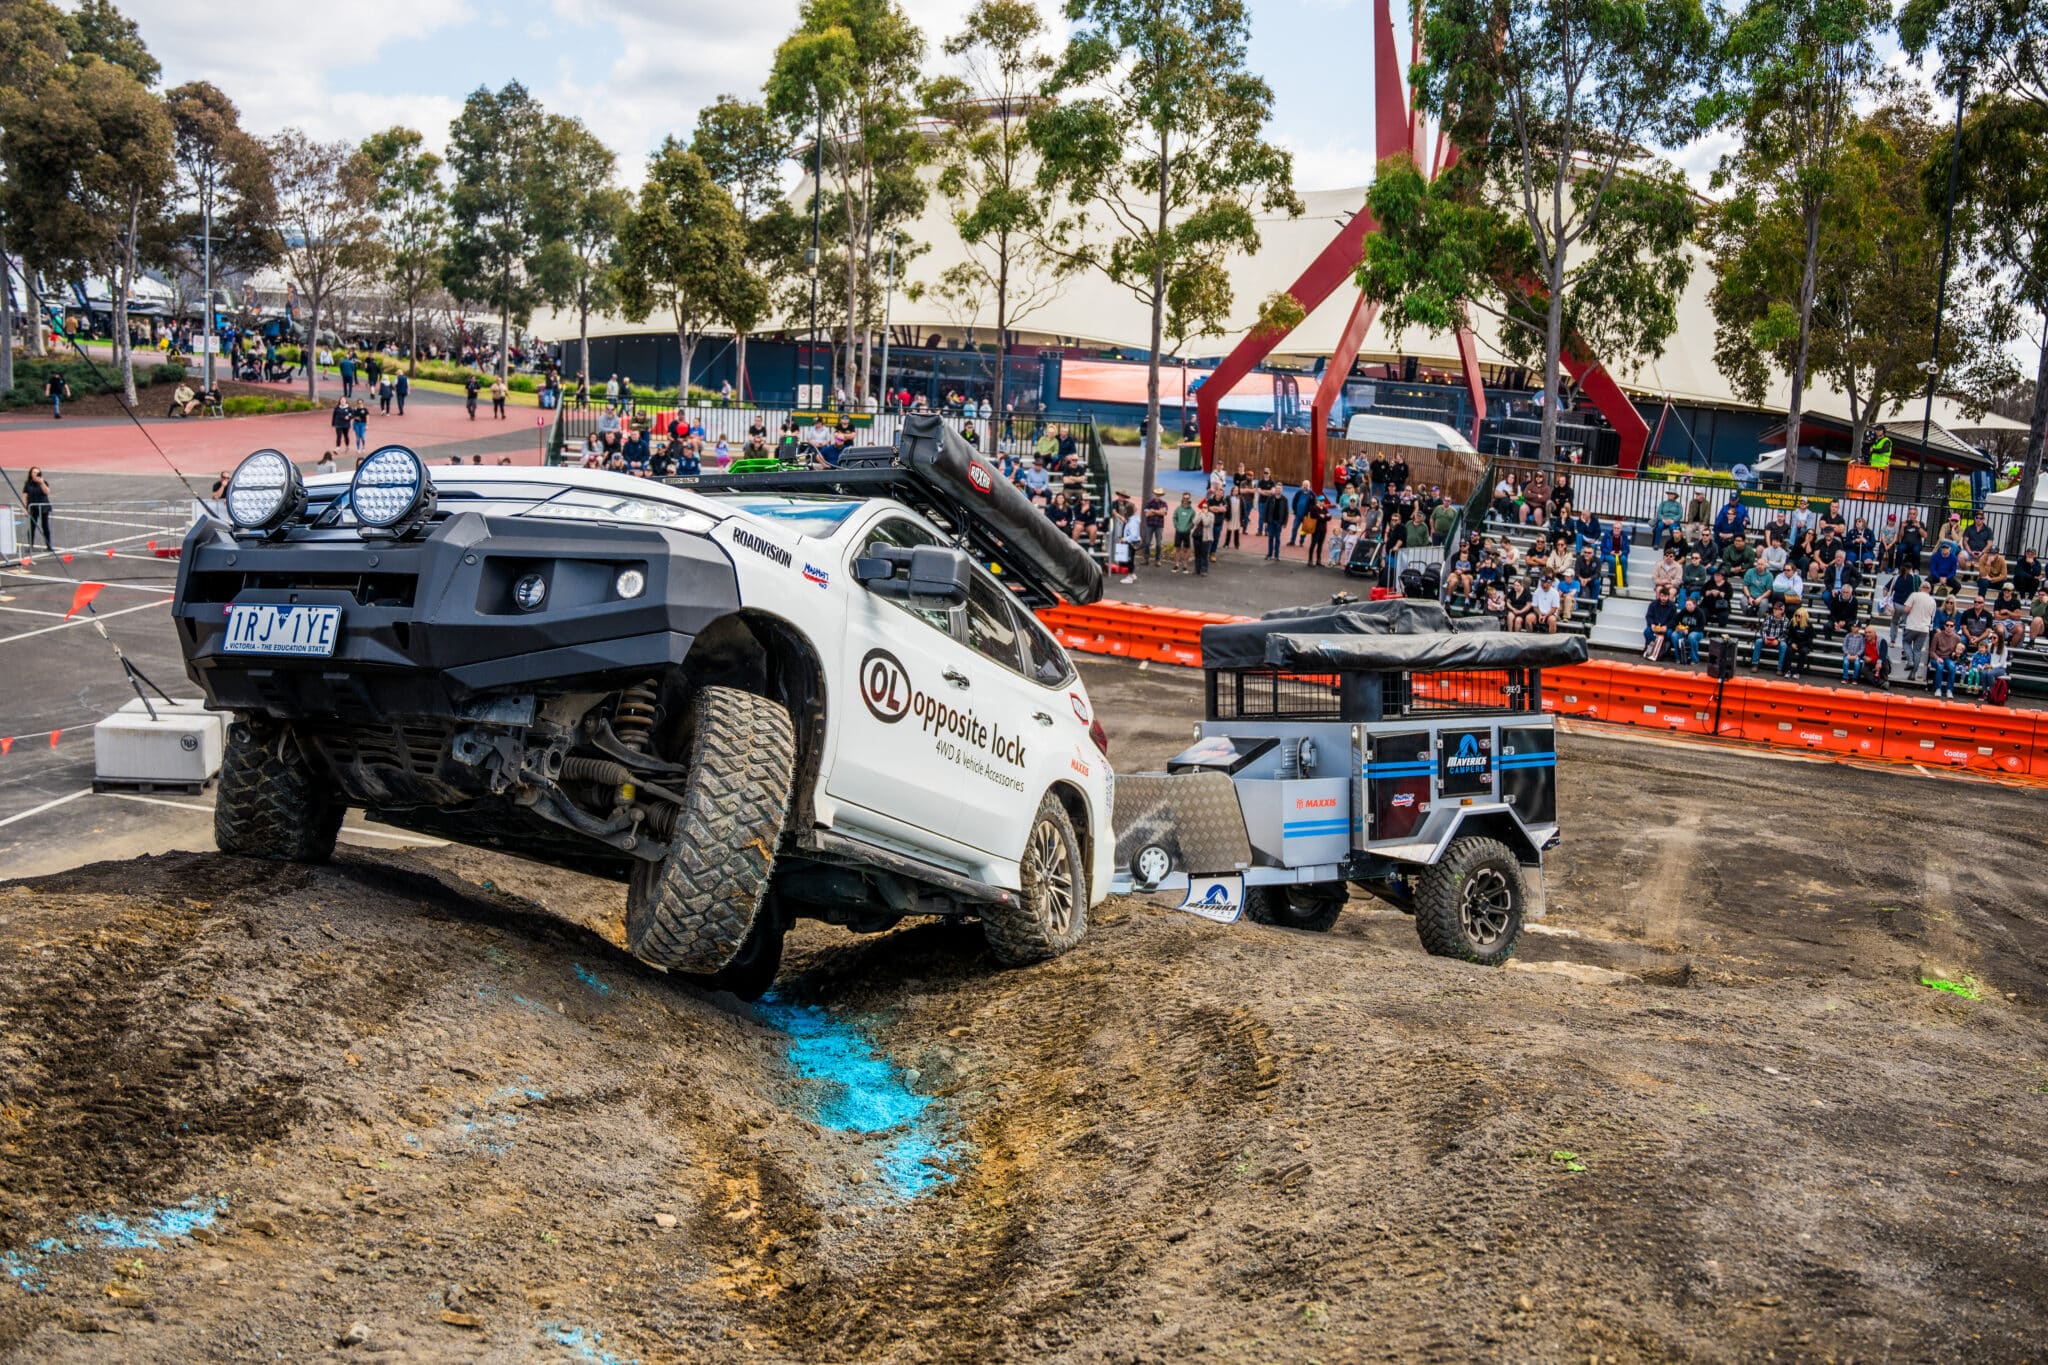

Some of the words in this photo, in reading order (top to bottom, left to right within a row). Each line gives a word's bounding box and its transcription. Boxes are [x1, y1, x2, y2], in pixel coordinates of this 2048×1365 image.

[1740, 490, 1771, 498] AUSTRALIAN
[1766, 498, 1780, 506] 1800
[233, 611, 275, 642] 1RJ
[292, 613, 335, 645] 1YE
[229, 642, 256, 650] VICTORIA
[913, 691, 987, 749] opposite
[991, 722, 1026, 769] lock
[1800, 731, 1823, 741] Coates
[1943, 749, 1968, 759] Coates
[935, 739, 955, 760] 4WD
[955, 748, 961, 764] &
[962, 751, 984, 775] Vehicle
[985, 763, 1025, 793] Accessories
[1447, 756, 1488, 768] MAVERICK
[1071, 758, 1089, 777] MAXXIS
[1449, 765, 1485, 775] CAMPERS
[1305, 798, 1337, 808] MAXXIS
